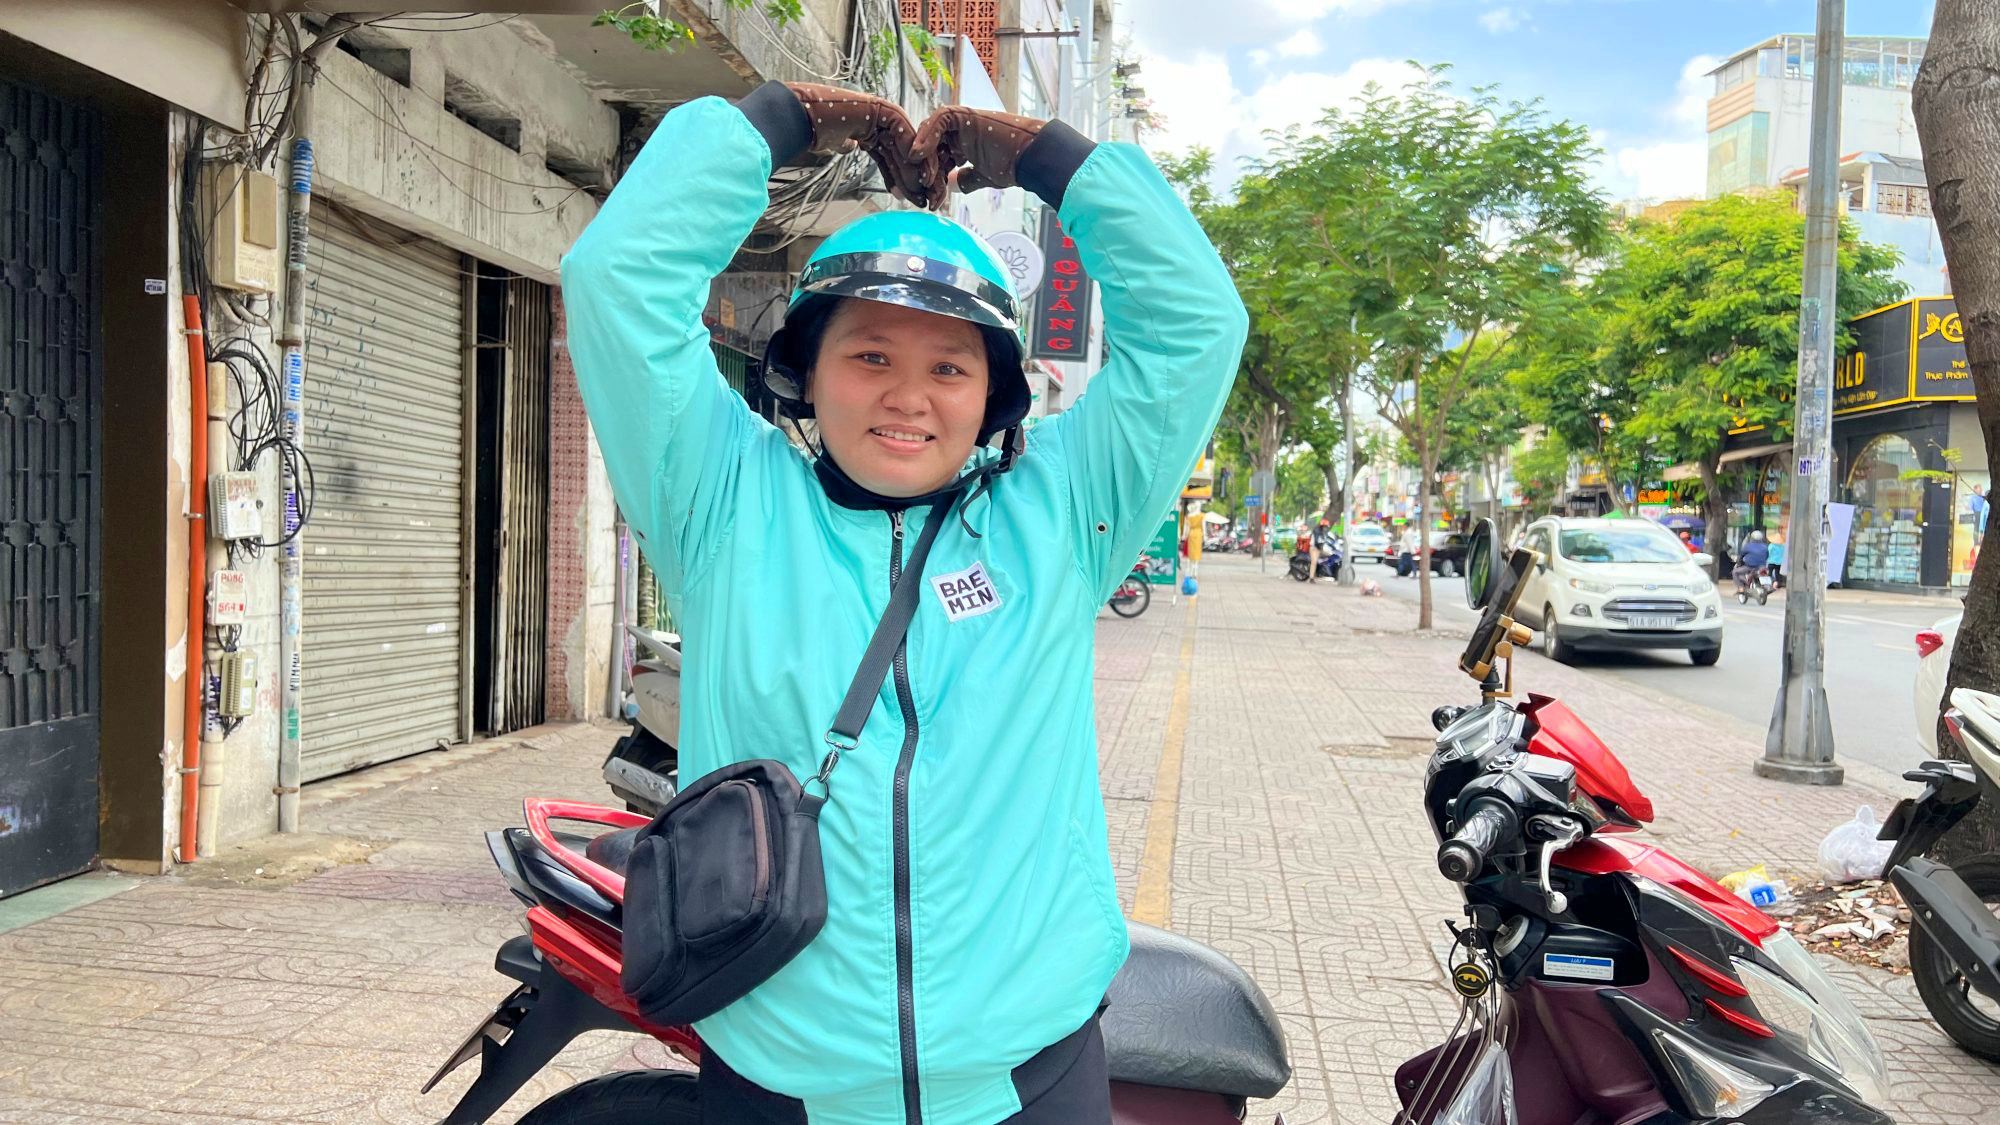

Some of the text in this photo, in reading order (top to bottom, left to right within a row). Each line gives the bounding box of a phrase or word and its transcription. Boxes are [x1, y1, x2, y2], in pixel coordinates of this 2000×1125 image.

[1047, 260, 1080, 350] QUẢNG
[1836, 351, 1865, 390] RLD
[939, 569, 986, 598] BAE
[947, 587, 994, 615] MIN
